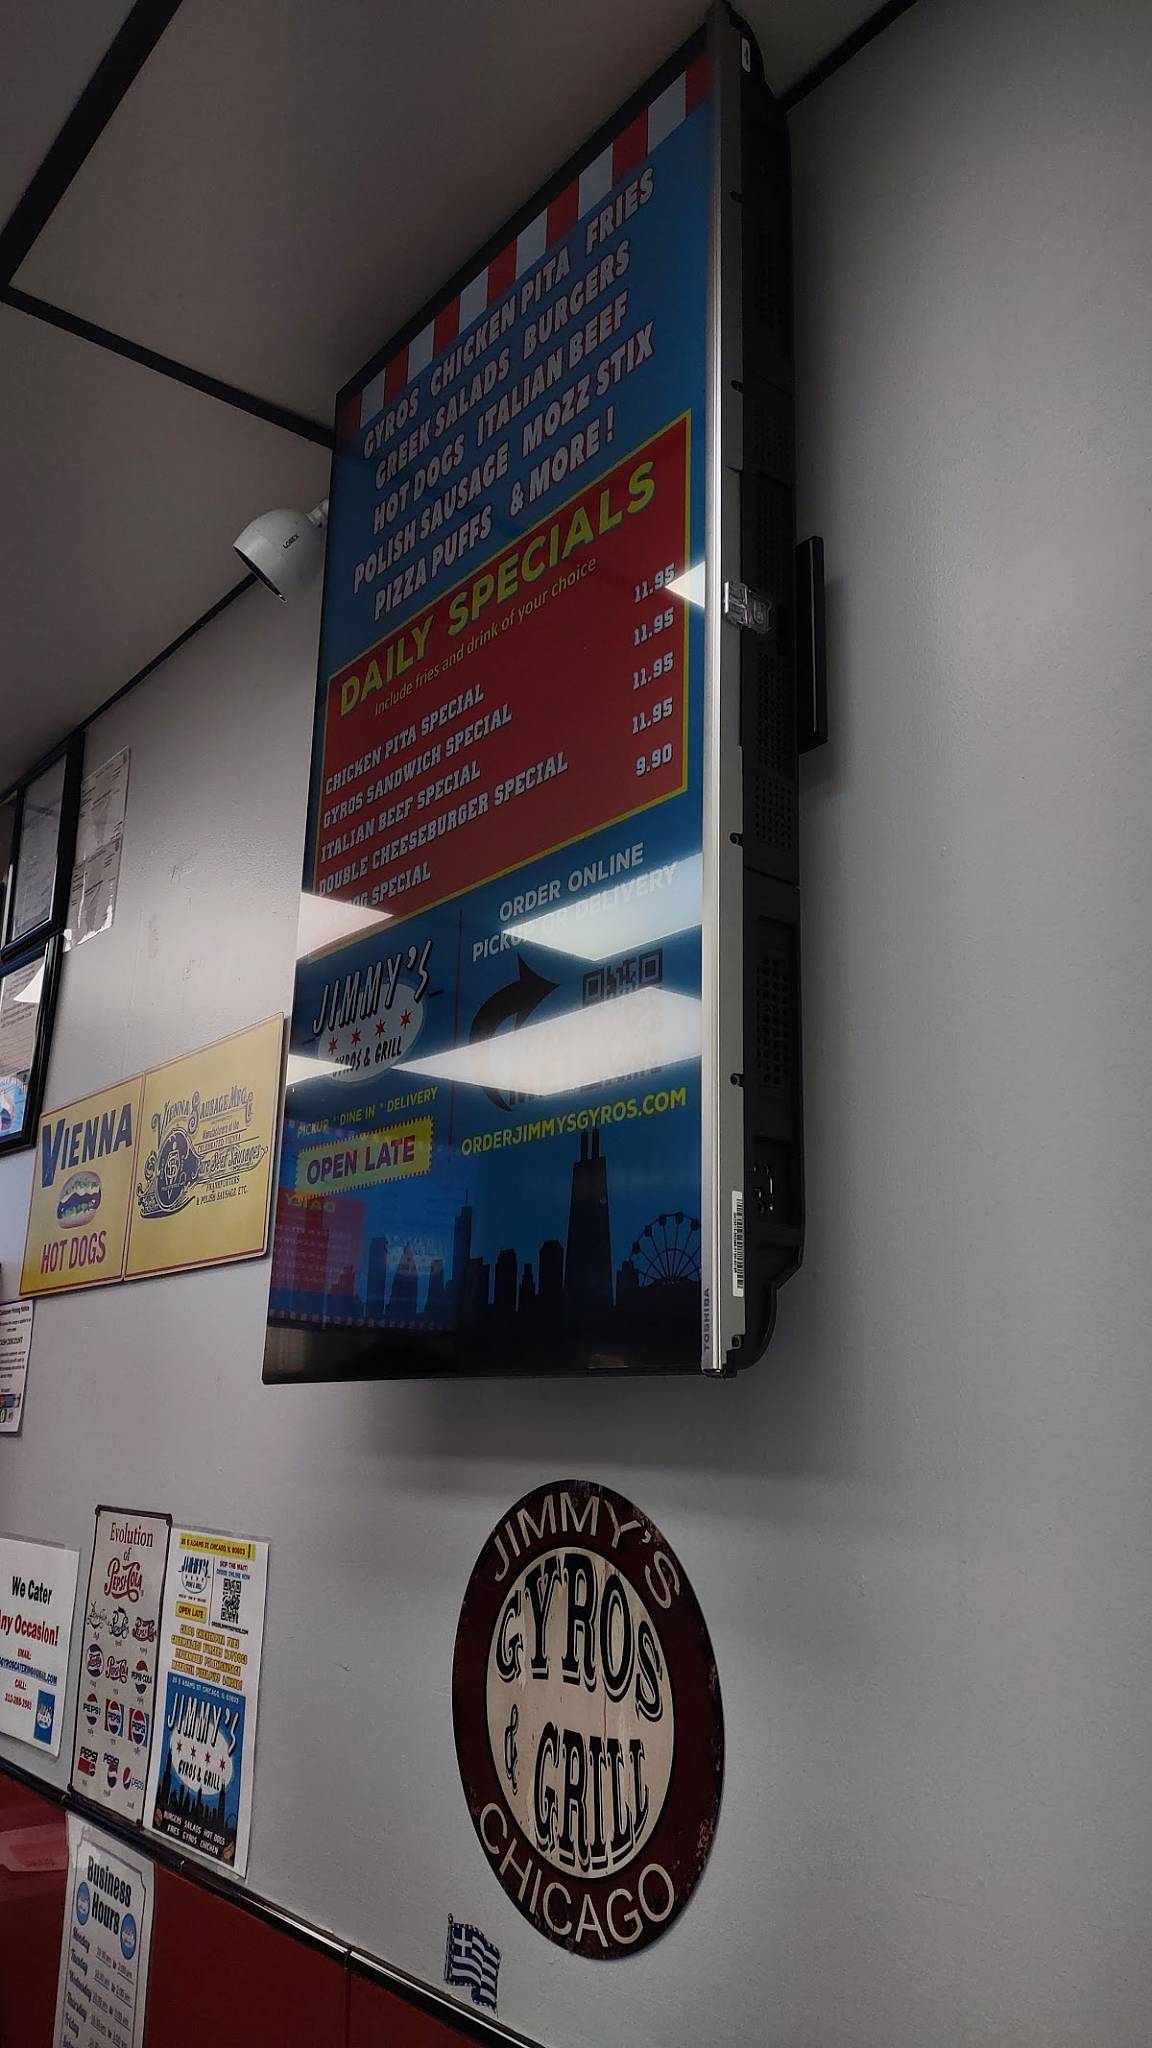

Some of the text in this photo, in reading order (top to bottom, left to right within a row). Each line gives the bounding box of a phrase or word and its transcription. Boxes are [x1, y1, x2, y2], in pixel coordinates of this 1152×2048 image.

[362, 168, 655, 460] GYROS CHICKEN PITA FRIES
[375, 240, 631, 489] GREEK SALADS BURGERS
[373, 291, 629, 537] HOT DOGS ITALIAN BEEF
[353, 320, 655, 595] POLISH SAUSAGE MOZZ STIX
[373, 557, 427, 623] PIZZA
[431, 504, 493, 579] PUFFS
[509, 479, 525, 518] &
[528, 418, 601, 503] MORE
[339, 461, 657, 717] DAILY SPECIALS
[633, 563, 675, 604] 11.95
[374, 557, 598, 717] Include fries and drink of your choice
[633, 607, 675, 647] 11.95
[632, 651, 674, 690] 11.95
[325, 682, 485, 796] CHICKEN PITA SPECIAL
[632, 697, 673, 735] 11.95
[323, 702, 513, 830] GYROS SANDWICH SPECIAL
[634, 743, 673, 777] 9.90
[319, 751, 569, 897] DOUBLE CHEESEBURGER SPECIAL
[320, 759, 482, 864] ITALIAN BEEF SPECIAL
[371, 860, 431, 905] SPECIAL
[499, 842, 644, 922] ORDER ONLINE
[575, 861, 677, 921] DELIVERY
[312, 939, 432, 1037] JIMMY'S
[363, 1046, 371, 1067] &
[374, 1035, 402, 1064] GRILL
[297, 1086, 439, 1138] PICKUP DINE IN DELIVERY
[461, 1086, 687, 1157] ORDERJIMMYSGYROS.COM
[40, 1102, 134, 1189] VIENNA
[306, 1134, 416, 1185] OPEN LATE
[41, 1229, 108, 1275] HOT DOGS
[703, 1288, 711, 1352] TOSHIBA
[109, 1521, 154, 1548] Evolution
[123, 1547, 132, 1561] of
[493, 1490, 681, 1610] JIMMY'S
[12, 1575, 53, 1605] We Cater
[178, 1604, 204, 1619] OPEN LATE
[14, 1614, 59, 1647] Occasion!
[495, 1551, 663, 1722] GYROS
[83, 1703, 101, 1717] PEPSI
[131, 1721, 146, 1735] PEPSI
[167, 1692, 239, 1758] JIMMY'S
[80, 1746, 98, 1764] PEPSI
[103, 1752, 120, 1766] PEPSI
[178, 1758, 221, 1791] GYROS & GRILL
[533, 1720, 650, 1868] GRILL
[167, 1824, 180, 1837] FRIES
[182, 1831, 197, 1845] GYROS
[184, 1816, 202, 1835] SALADS
[203, 1826, 213, 1839] HOT
[213, 1832, 226, 1846] DOGS
[87, 1855, 132, 1908] Business
[479, 1802, 675, 1948] CHICAGO
[91, 1891, 121, 1936] Hours
